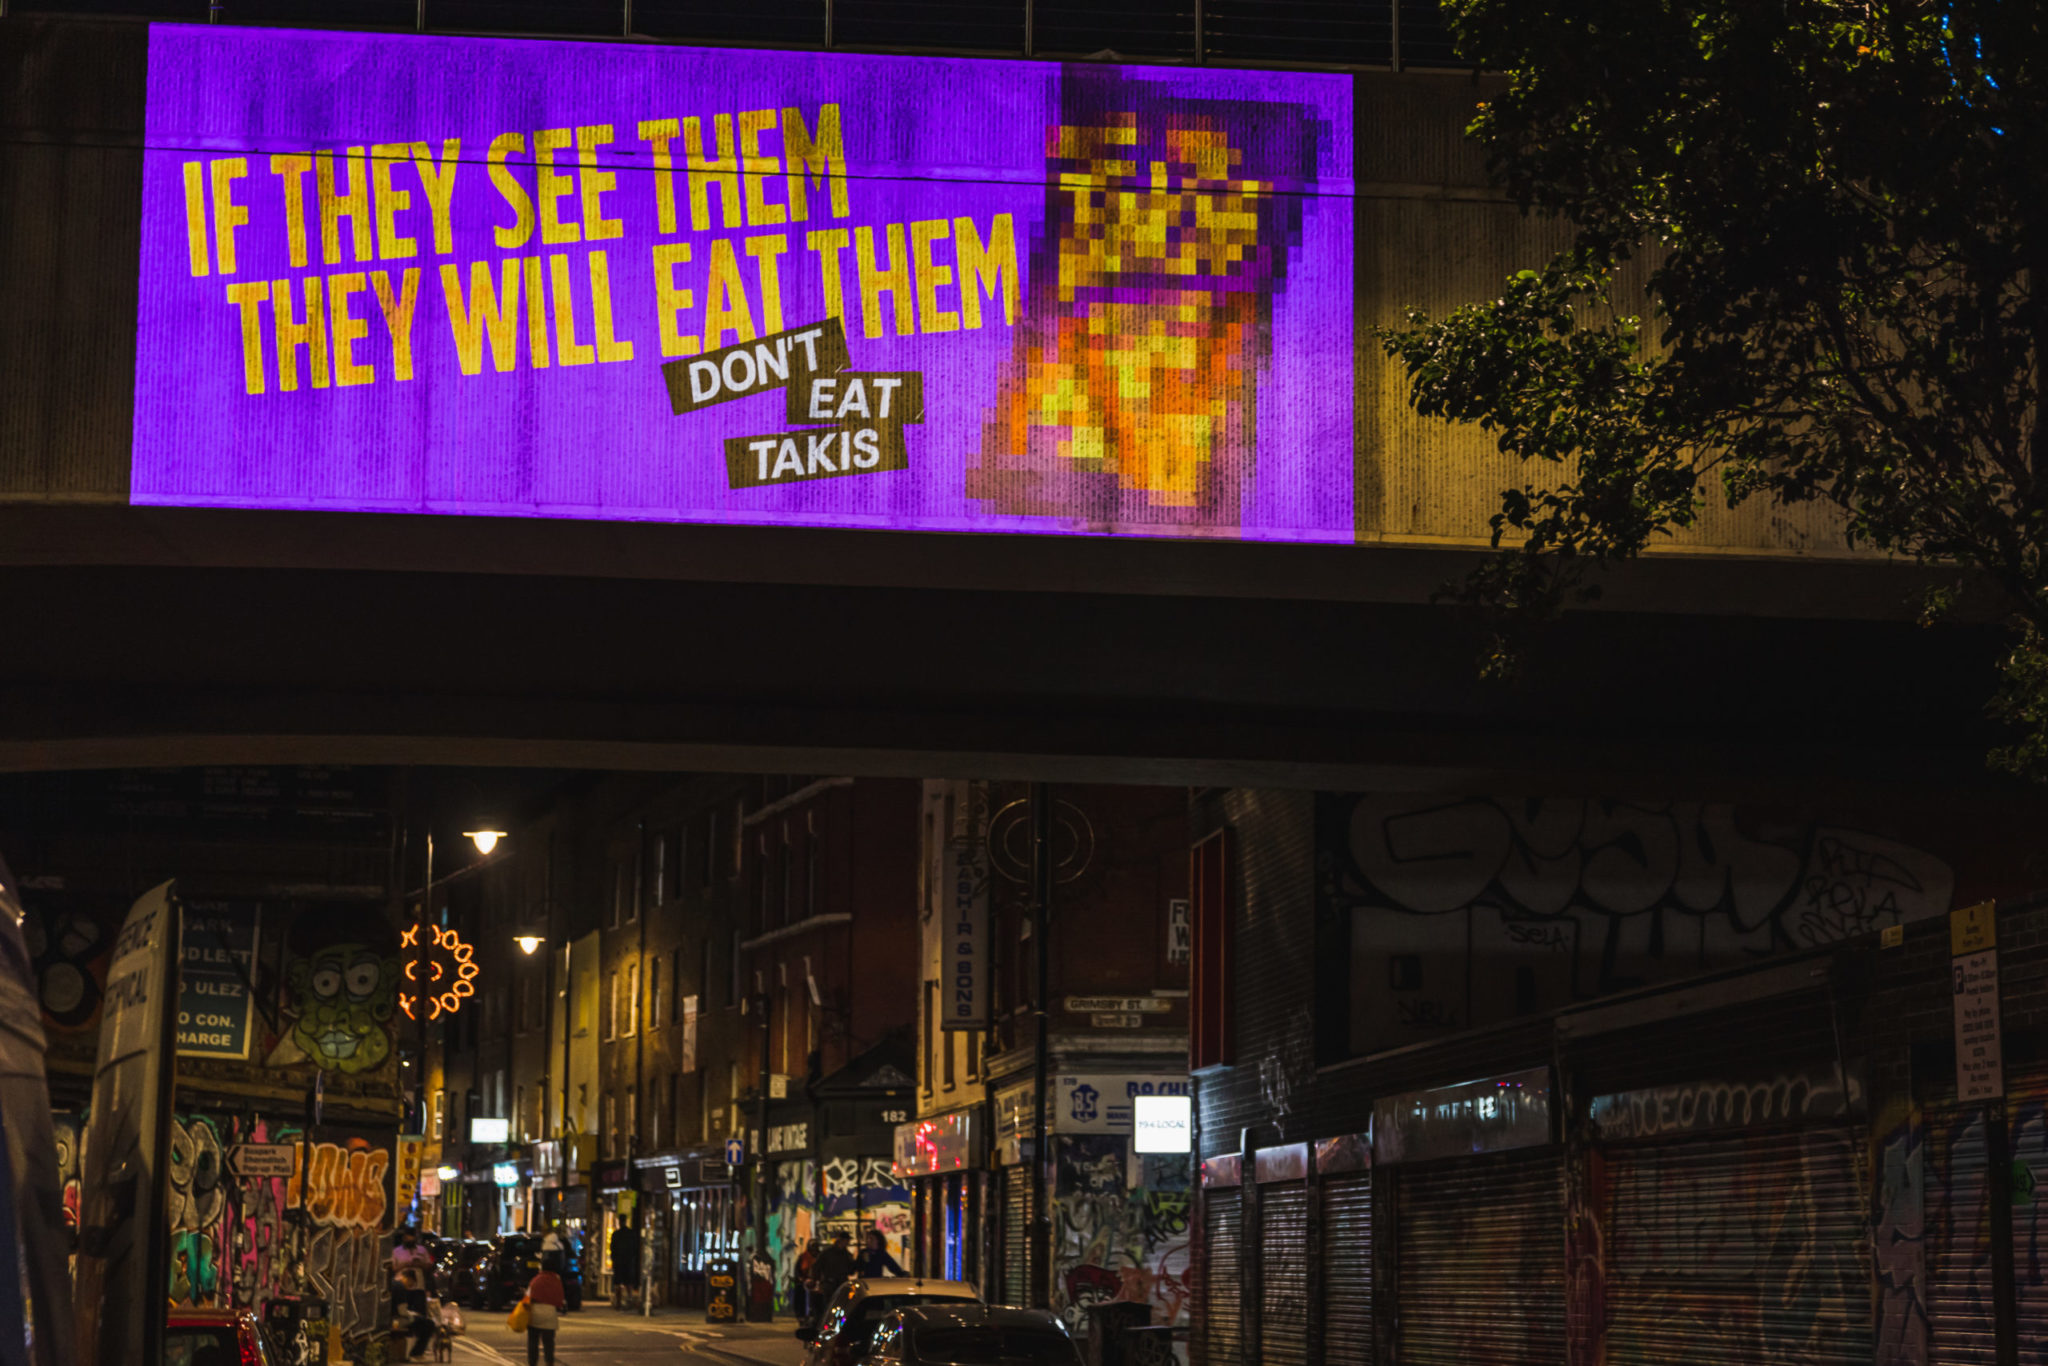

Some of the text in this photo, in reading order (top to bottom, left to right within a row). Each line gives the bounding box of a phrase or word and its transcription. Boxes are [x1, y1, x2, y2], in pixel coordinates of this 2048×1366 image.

[183, 103, 850, 277] IF THEY SEE THEM
[226, 213, 1023, 394] THEY WILL EAT THEM
[688, 327, 823, 404] DON'T
[808, 377, 902, 419] EAT
[748, 427, 881, 481] TAKIS
[195, 981, 242, 997] ULEZ
[176, 1031, 232, 1047] HARGE
[195, 1013, 235, 1028] CON.
[882, 1111, 907, 1123] 182
